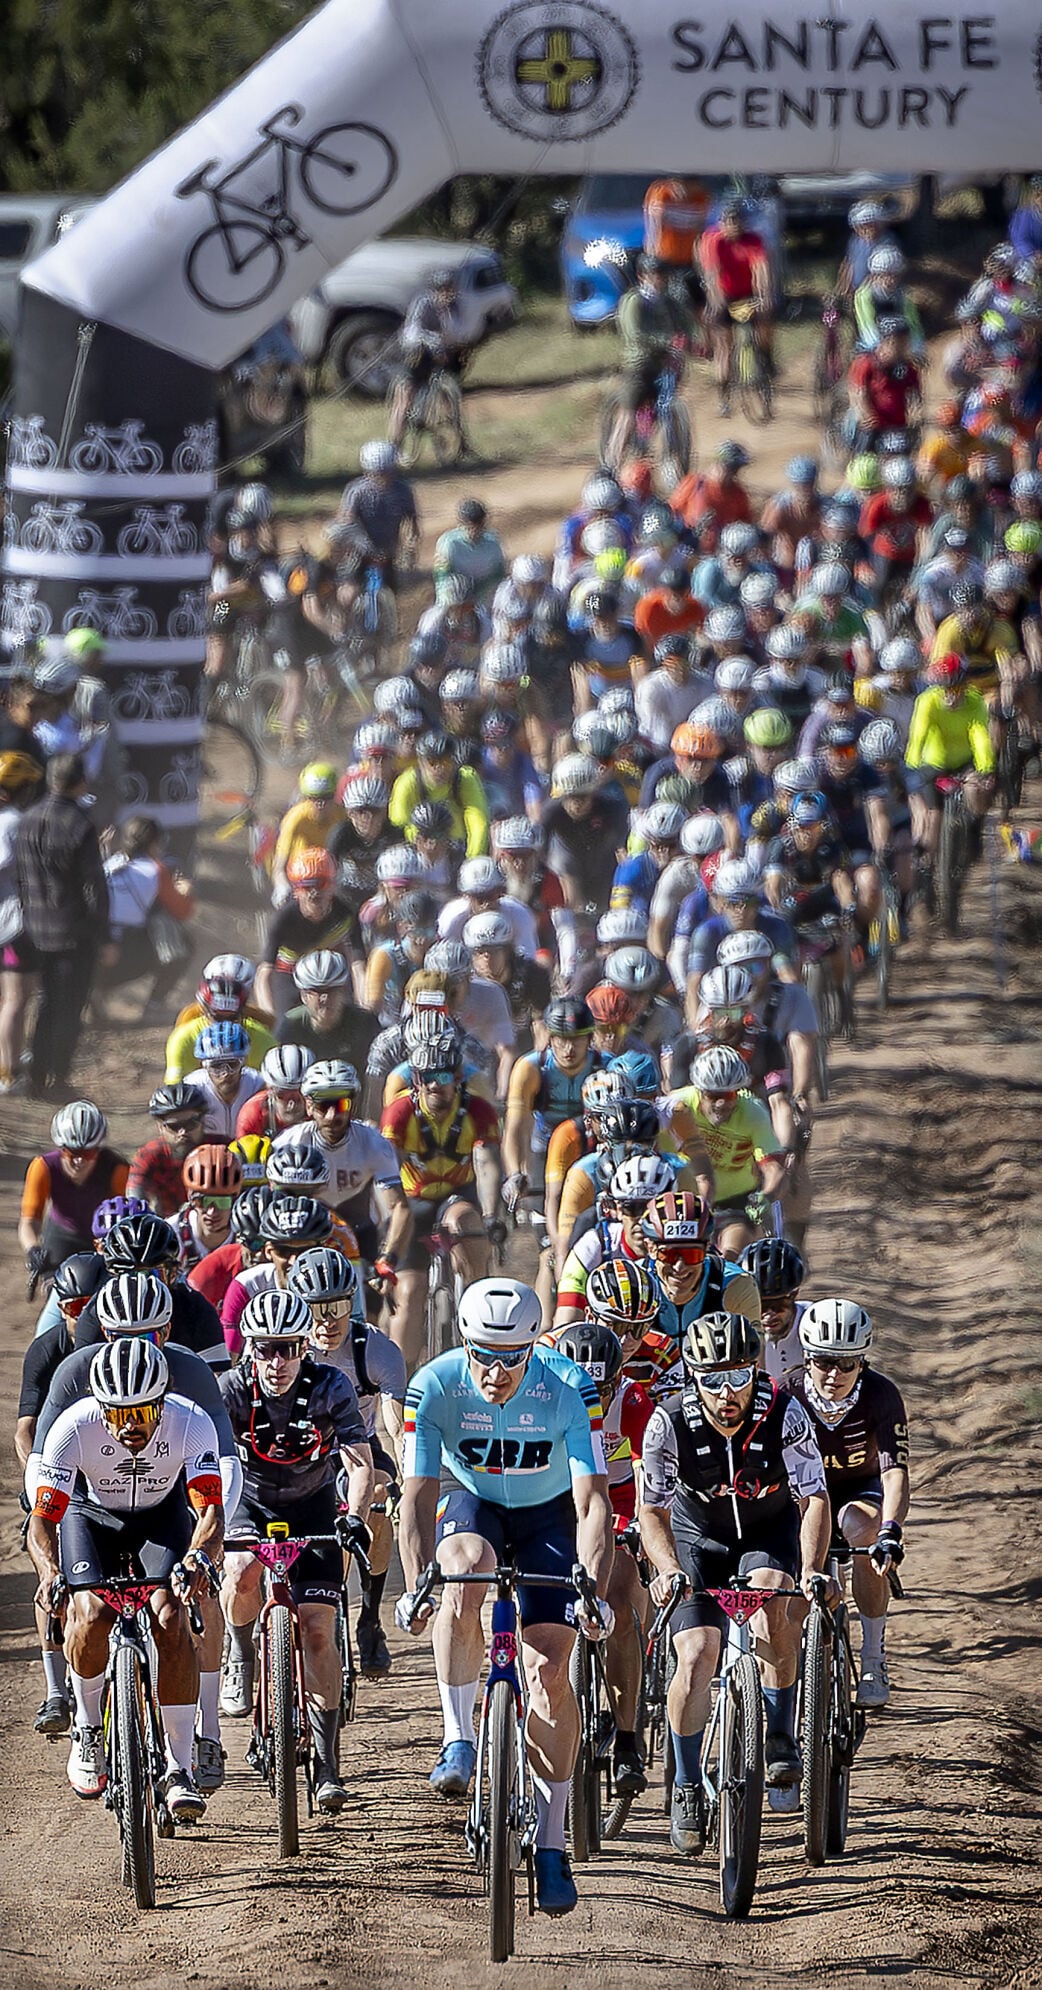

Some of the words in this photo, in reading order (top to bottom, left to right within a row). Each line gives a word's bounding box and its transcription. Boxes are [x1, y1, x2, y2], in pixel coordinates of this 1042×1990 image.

[672, 17, 900, 72] SANTA
[919, 16, 997, 72] FE
[700, 86, 968, 130] CENTURY
[667, 1225, 695, 1236] 2124
[458, 1438, 554, 1470] SBR
[263, 1545, 294, 1561] 2147
[723, 1593, 758, 1609] 2156
